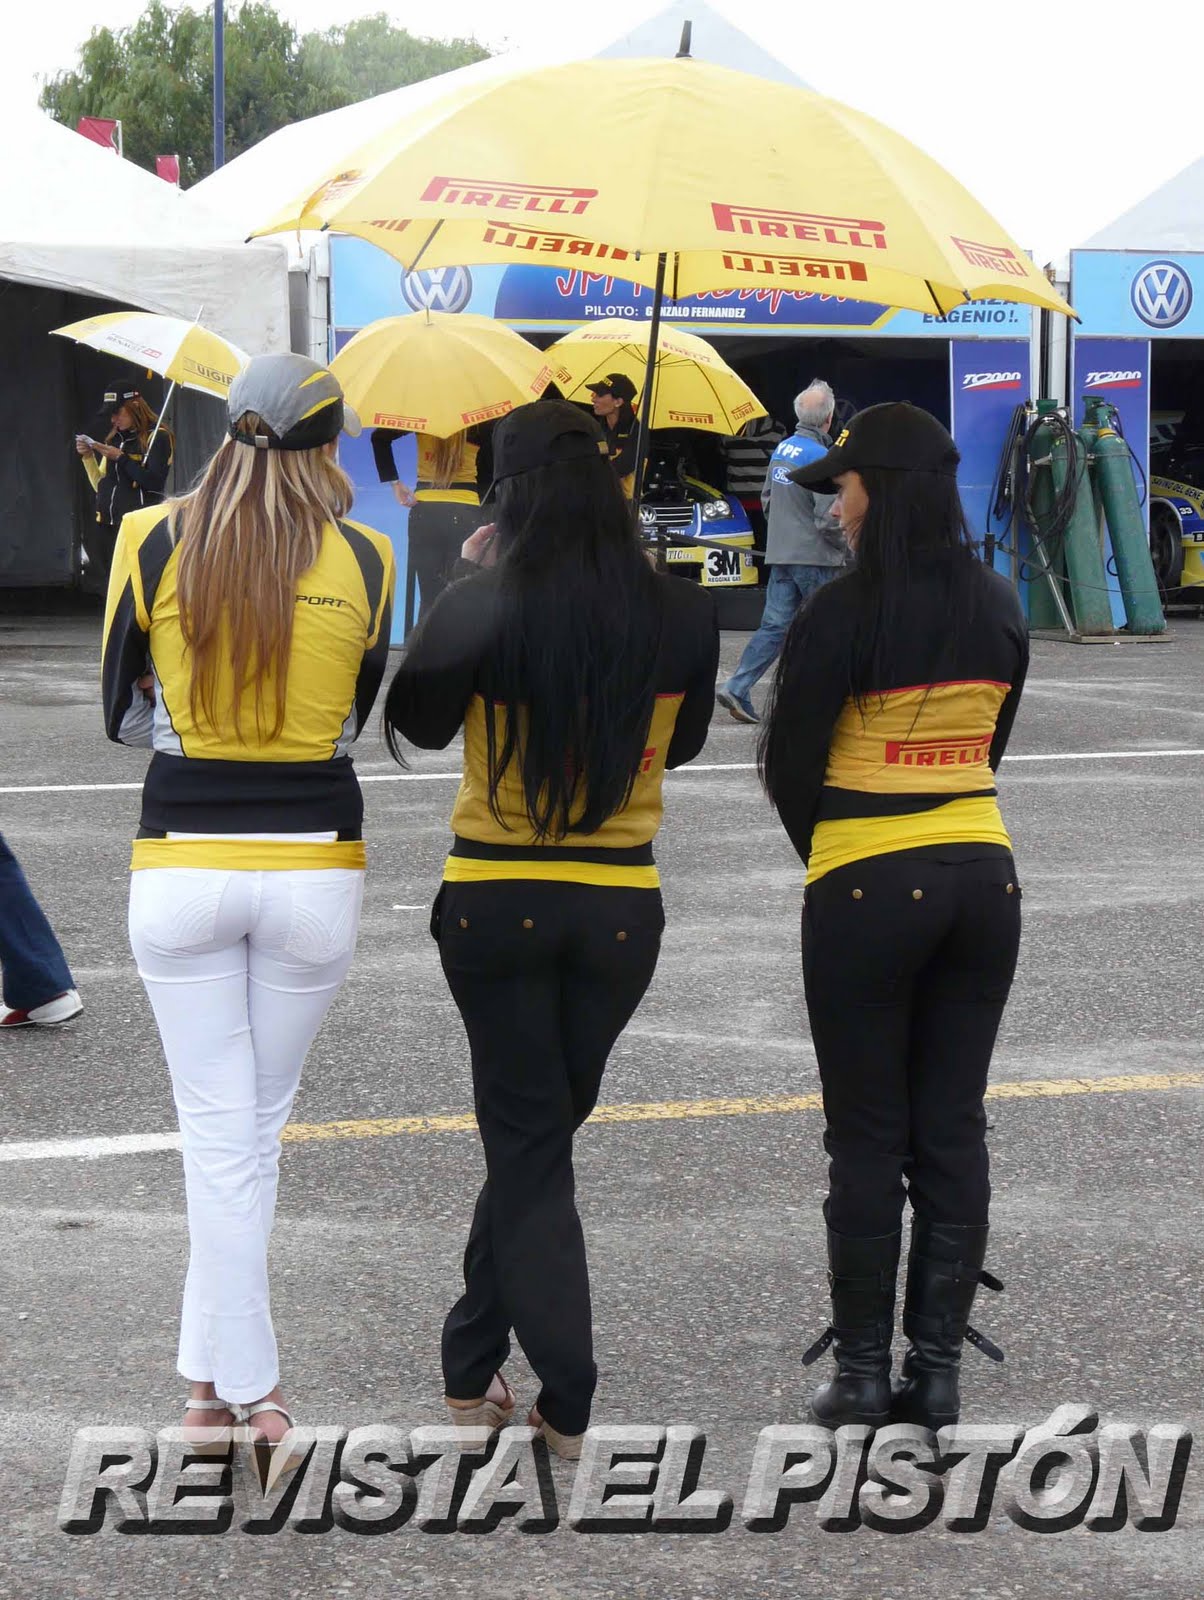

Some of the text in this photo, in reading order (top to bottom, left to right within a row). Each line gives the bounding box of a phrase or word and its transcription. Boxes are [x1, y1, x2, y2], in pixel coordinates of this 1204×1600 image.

[419, 176, 598, 214] PIRELLI
[711, 202, 887, 249] PIRELLI
[951, 236, 1029, 277] PIRELLI
[584, 305, 745, 319] PILOTO: GNZALO FERNANDEZ
[962, 371, 1021, 389] TC2000
[1084, 370, 1142, 388] TC2000
[462, 400, 513, 424] PIRELLI
[374, 413, 427, 430] PIRELLI
[777, 442, 803, 458] YPF
[1179, 507, 1193, 515] 33
[708, 550, 740, 576] 3M
[295, 594, 347, 608] PORT
